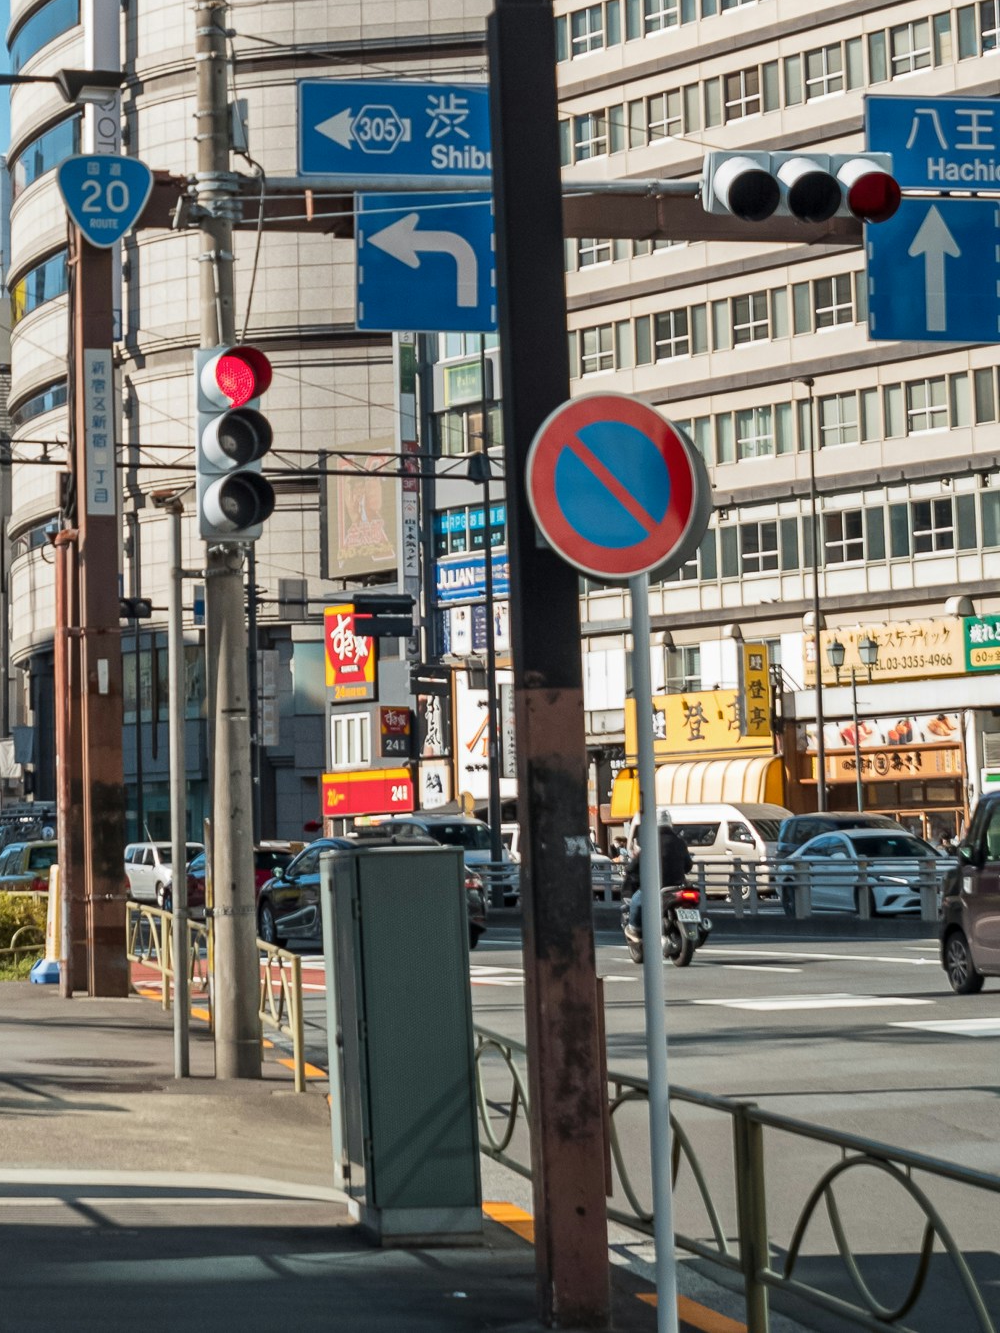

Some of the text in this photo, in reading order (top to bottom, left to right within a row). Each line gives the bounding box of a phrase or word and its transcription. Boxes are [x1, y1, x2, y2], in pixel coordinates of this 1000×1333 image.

[359, 117, 397, 141] 305
[81, 179, 129, 213] 20
[89, 217, 119, 230] ROUTE
